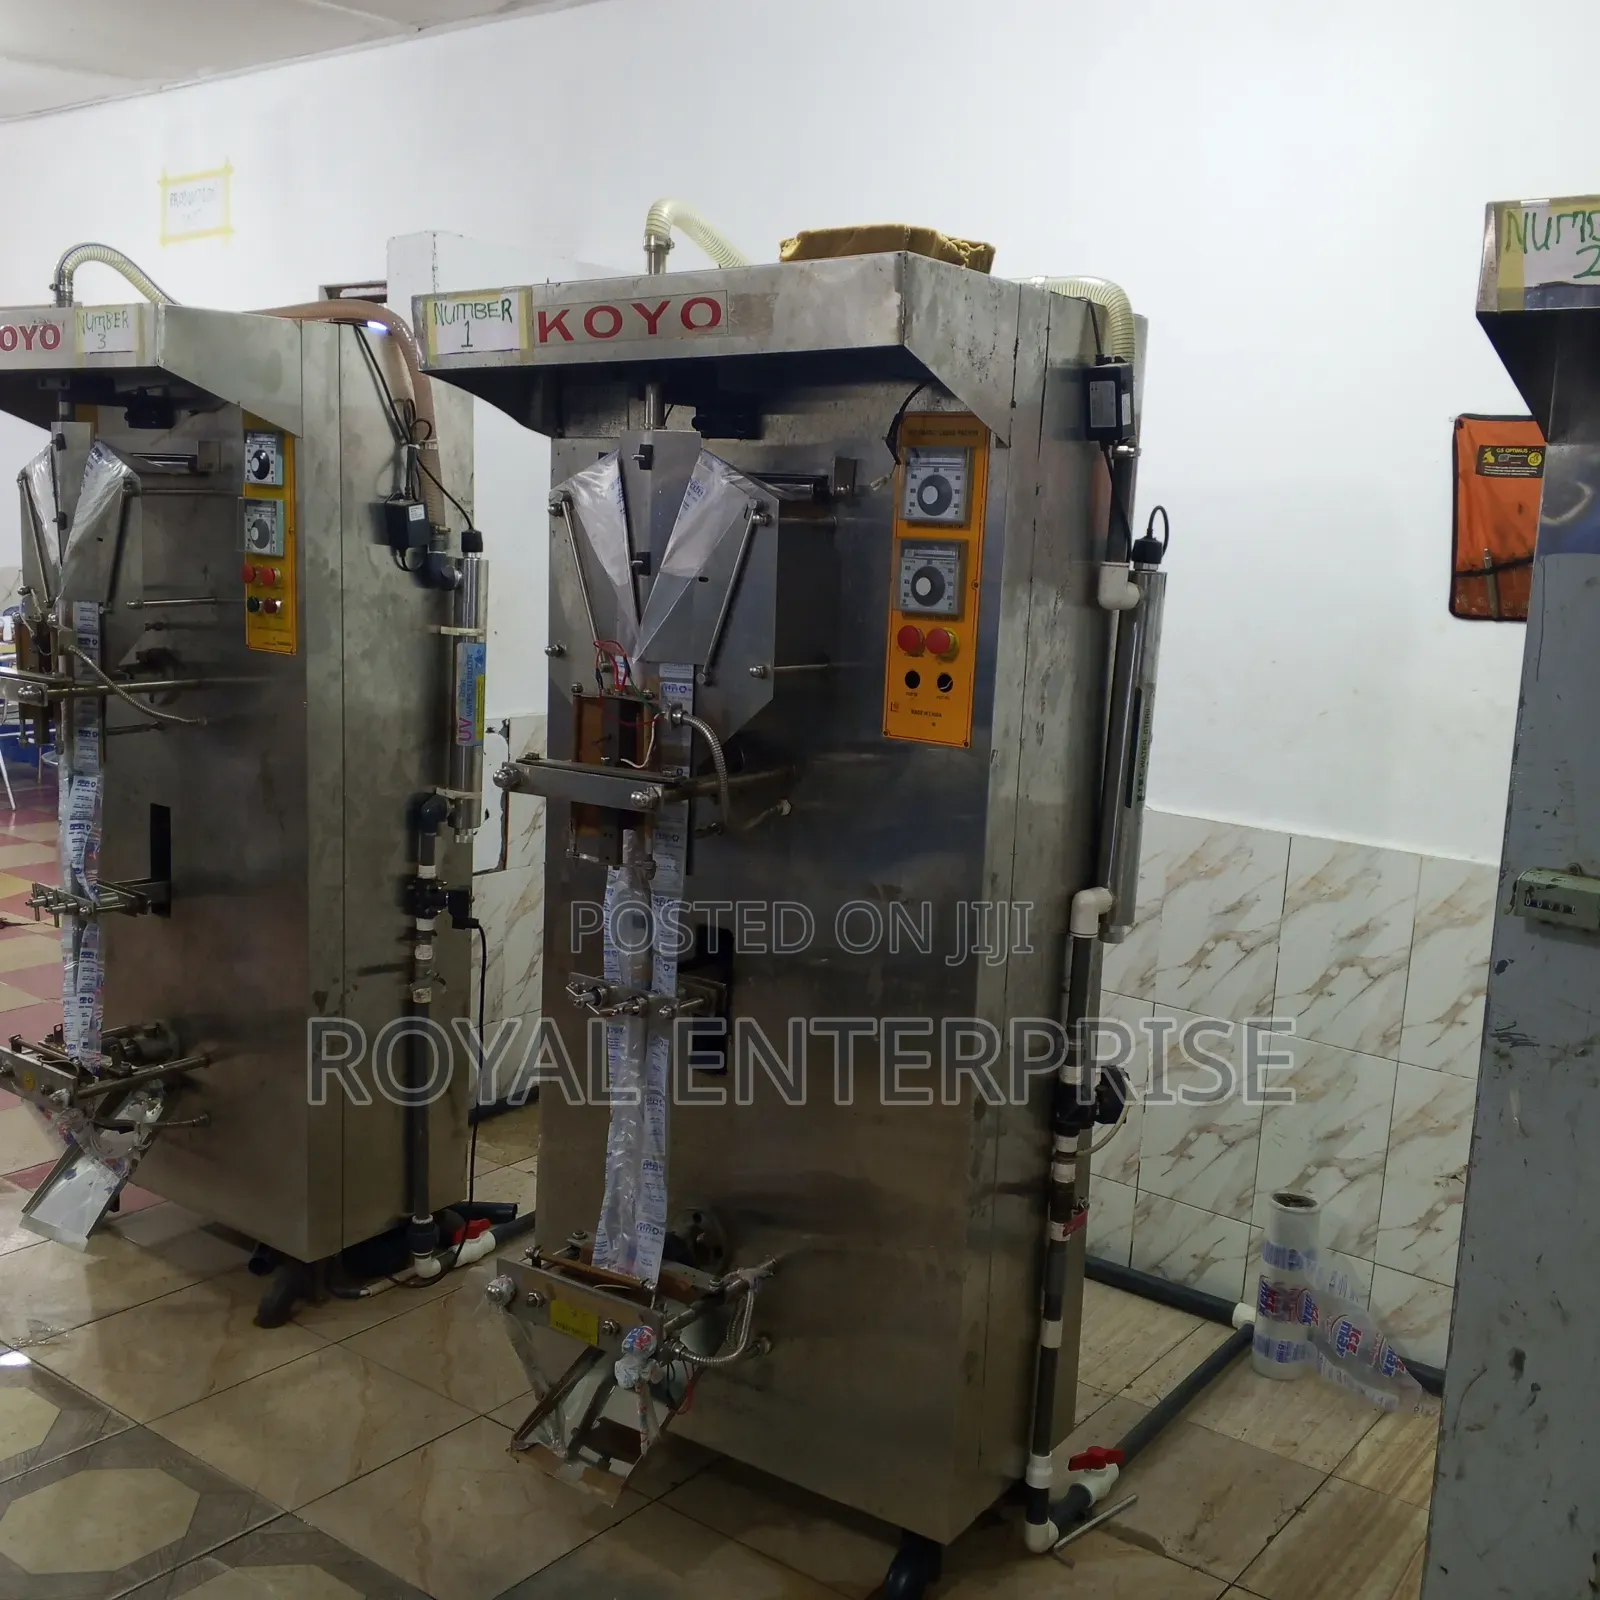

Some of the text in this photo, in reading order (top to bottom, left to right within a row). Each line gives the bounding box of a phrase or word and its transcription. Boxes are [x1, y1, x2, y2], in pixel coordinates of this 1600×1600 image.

[76, 310, 130, 336] NUMBER
[433, 298, 513, 325] NUMBER
[537, 296, 722, 344] KOYO
[0, 323, 61, 352] OYO
[97, 333, 107, 350] 3
[458, 717, 473, 743] UV
